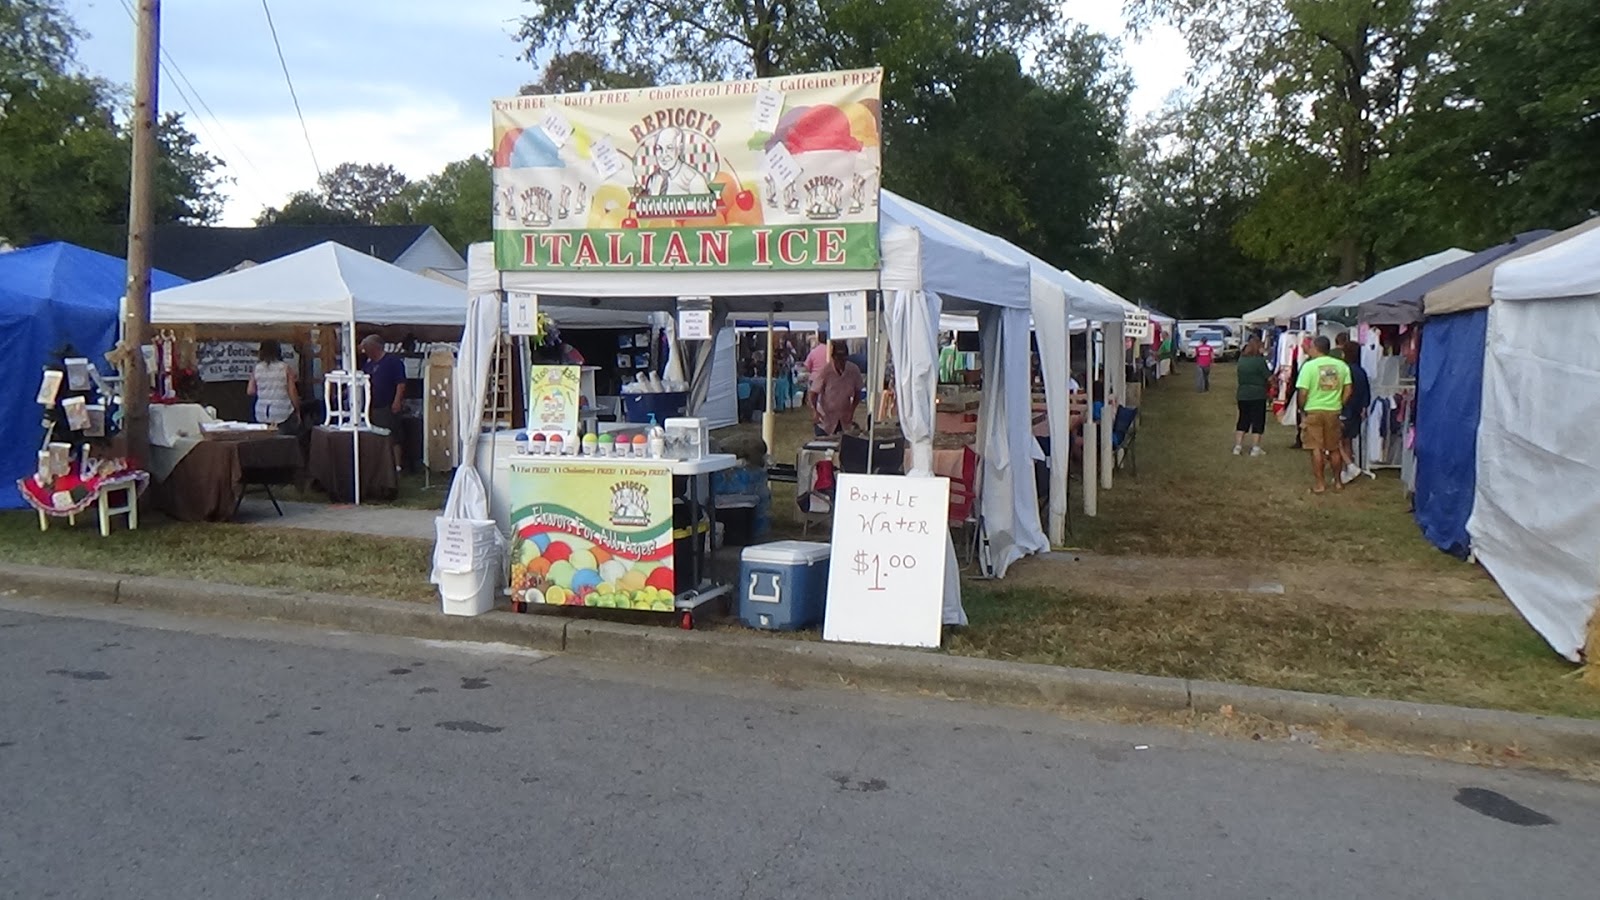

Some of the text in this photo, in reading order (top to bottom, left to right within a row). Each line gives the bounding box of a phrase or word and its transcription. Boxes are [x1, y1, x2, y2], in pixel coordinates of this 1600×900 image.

[517, 98, 546, 110] FREE
[564, 96, 595, 108] Dairy
[599, 92, 631, 104] FREE
[649, 85, 720, 101] Cholesterol
[725, 81, 759, 95] FREE
[780, 76, 837, 91] Caffeine
[842, 71, 880, 86] FREE
[629, 107, 722, 143] REPICCI'S
[520, 228, 847, 266] ITALIAN ICE
[532, 505, 572, 533] Flavors
[574, 515, 595, 541] For
[622, 535, 657, 562] Ages!
[851, 549, 917, 591] $1.00
